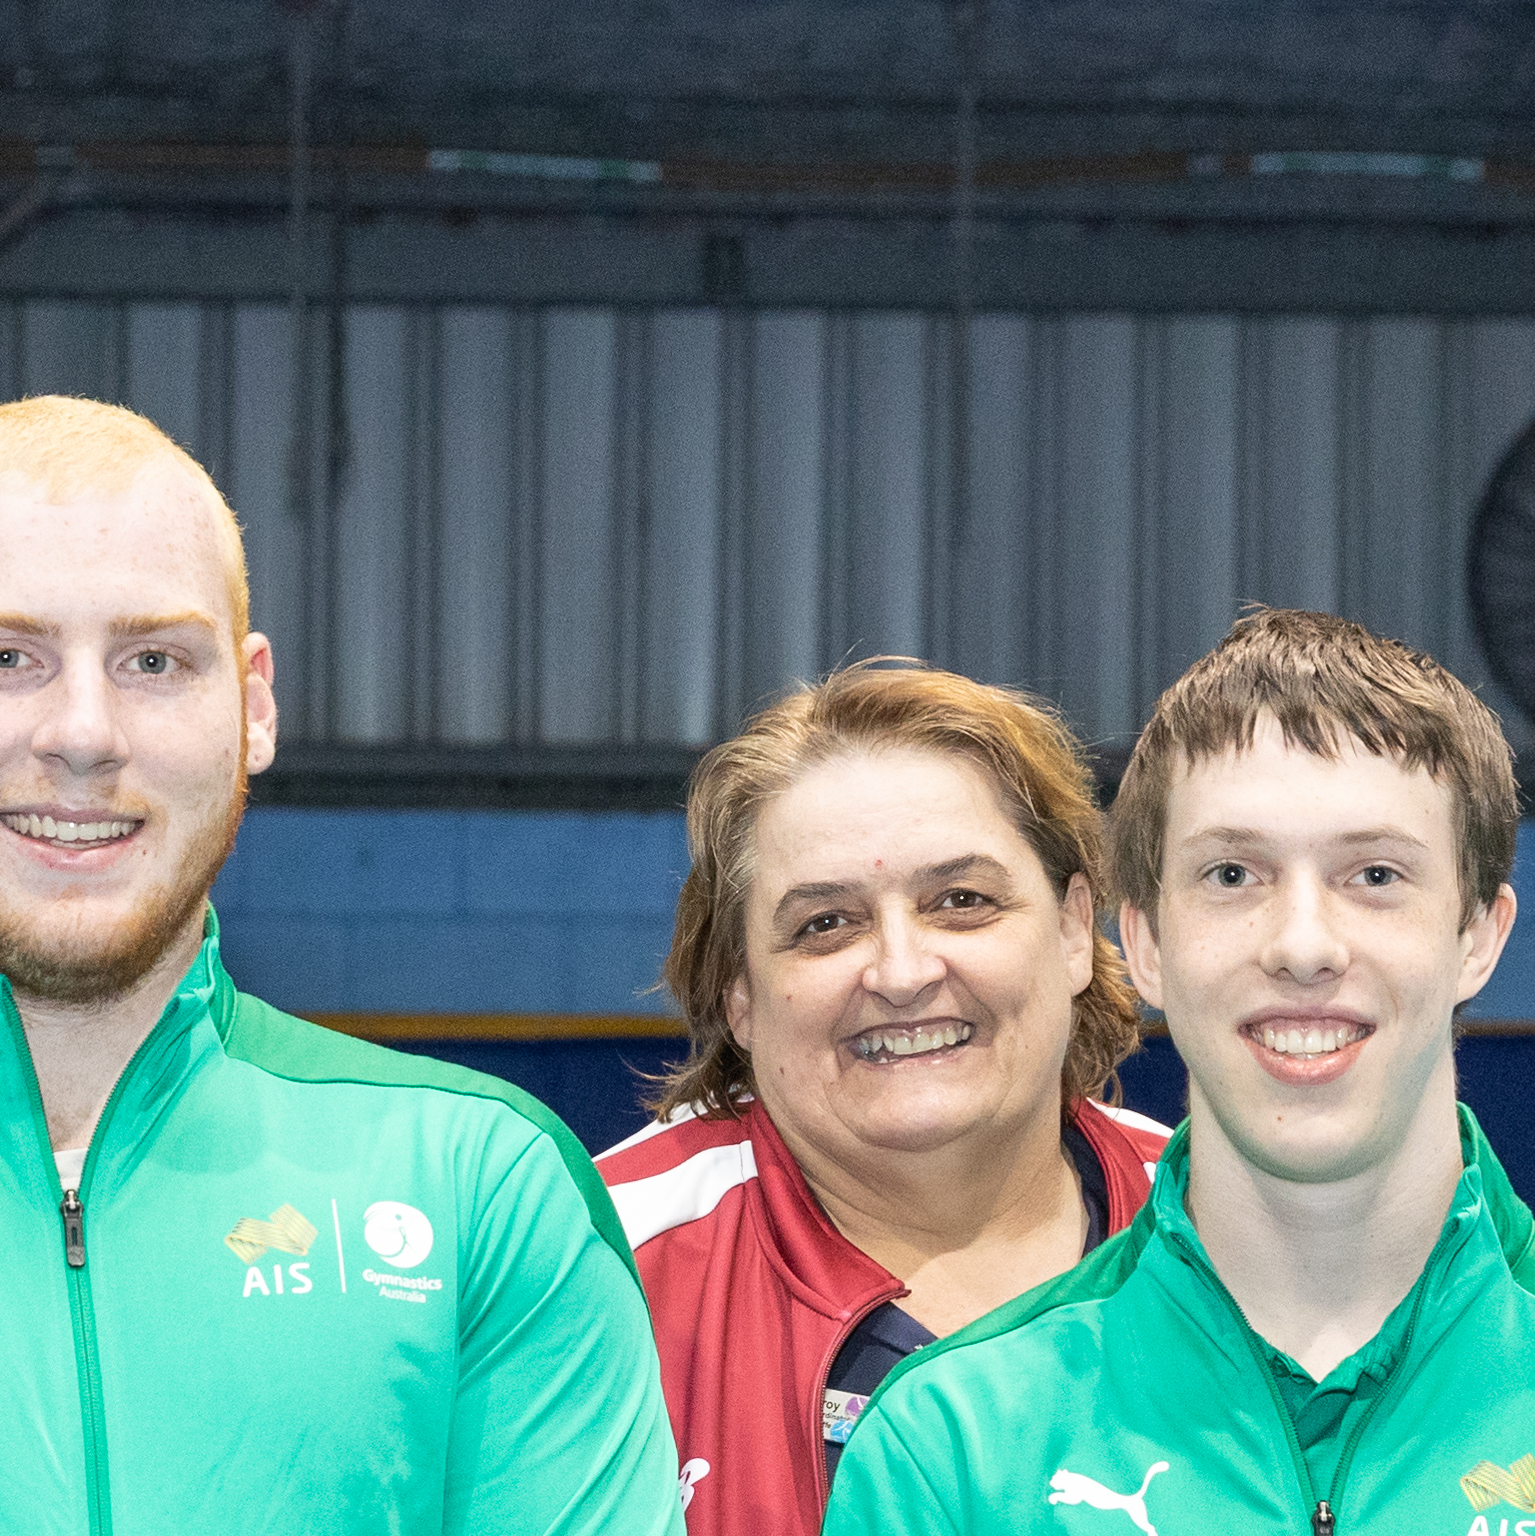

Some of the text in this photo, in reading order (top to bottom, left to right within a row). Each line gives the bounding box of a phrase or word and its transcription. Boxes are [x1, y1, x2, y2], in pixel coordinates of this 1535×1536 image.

[242, 1262, 313, 1298] AIS
[362, 1268, 443, 1291] Gymnastics
[378, 1285, 427, 1304] Australia
